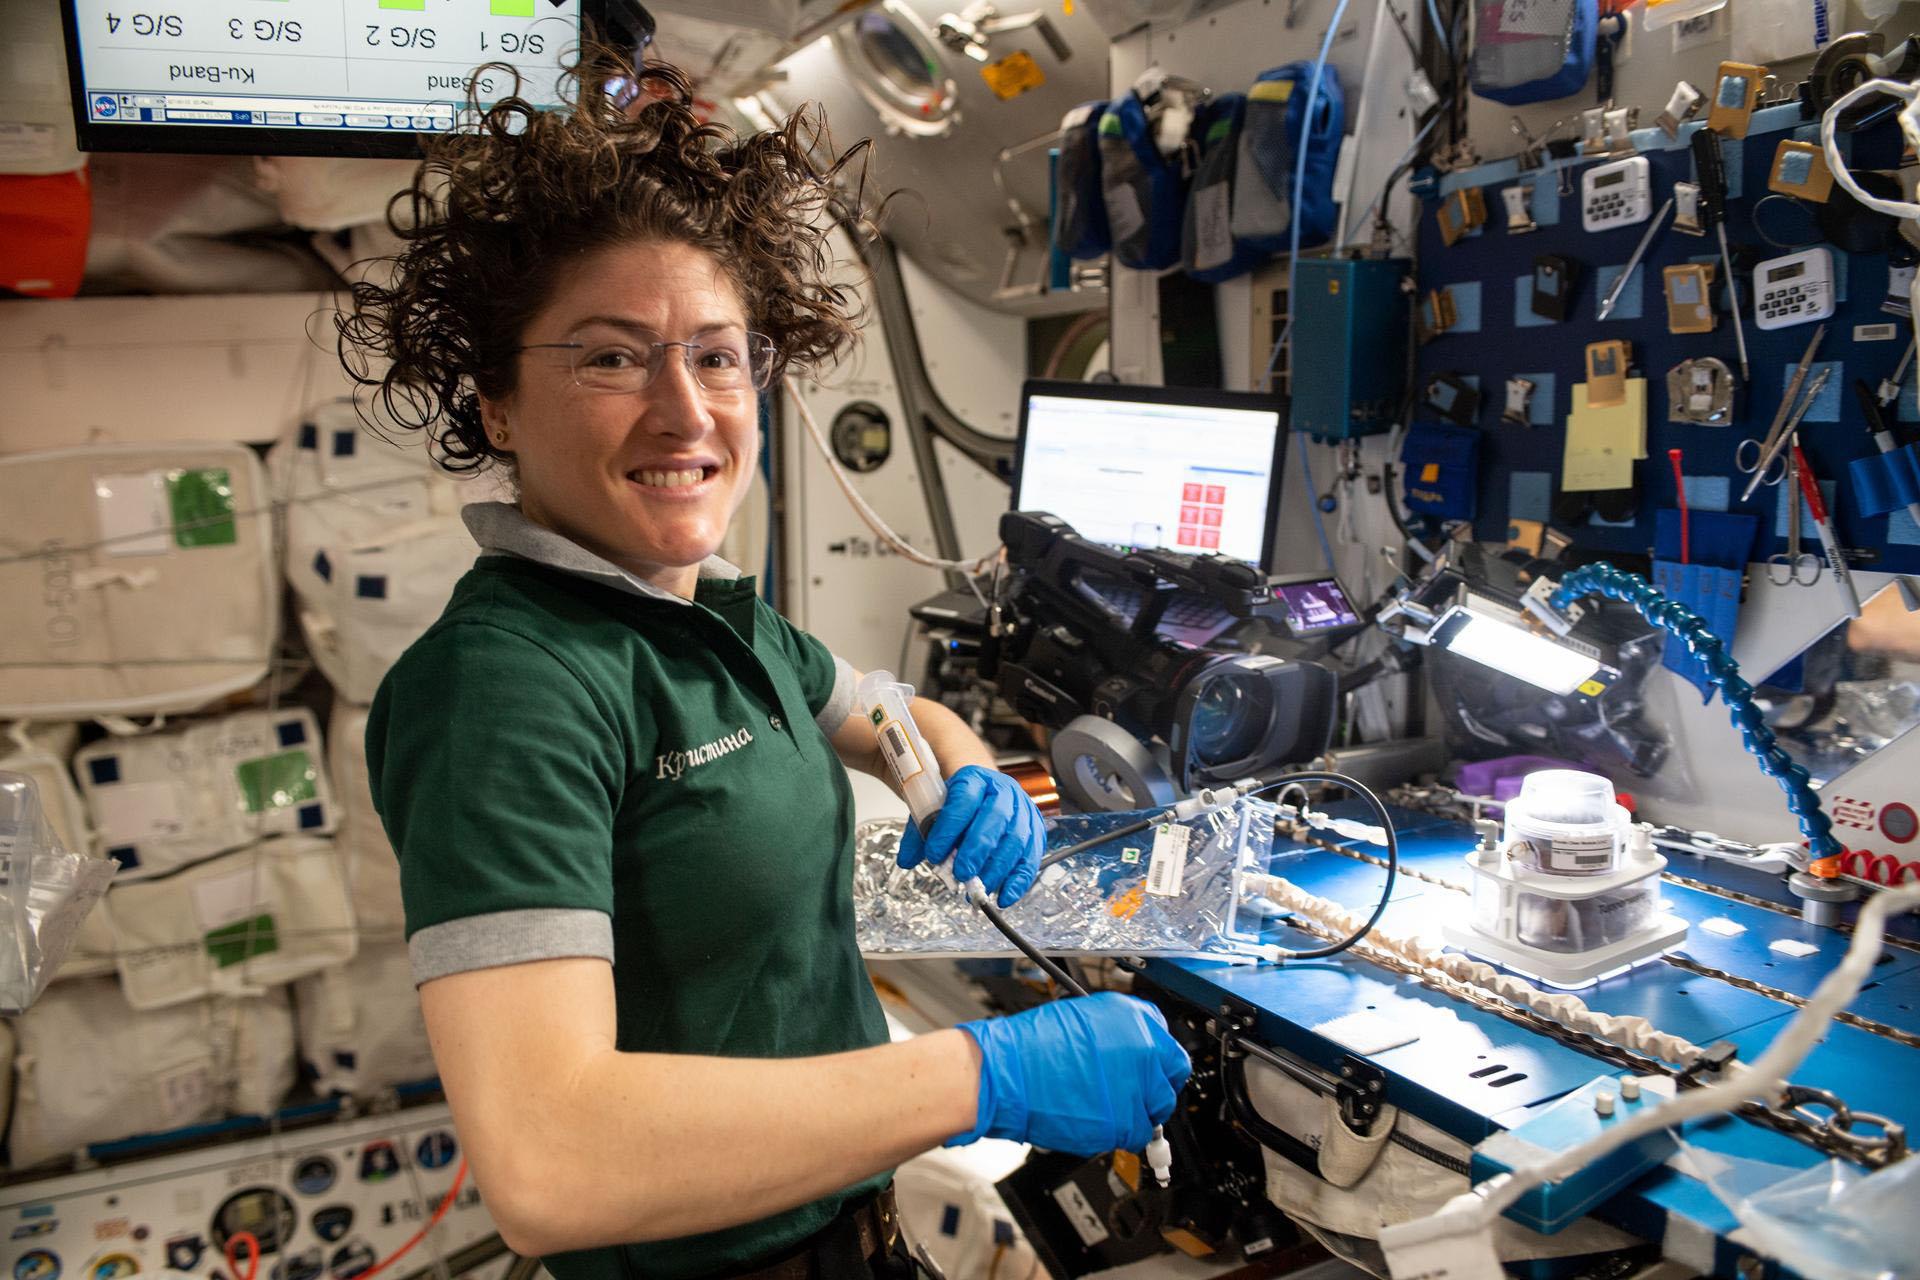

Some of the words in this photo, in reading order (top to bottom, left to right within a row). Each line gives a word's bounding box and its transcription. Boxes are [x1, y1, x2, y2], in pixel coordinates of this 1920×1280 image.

[105, 12, 121, 34] 4
[132, 14, 183, 37] S/G
[228, 18, 243, 40] 3
[254, 19, 302, 42] S/G
[366, 25, 380, 46] 2
[391, 26, 436, 49] S/G
[480, 31, 489, 51] 1
[501, 32, 545, 54] S/G
[170, 65, 255, 84] Ku-Band
[428, 75, 494, 94] S-Band
[1023, 678, 1057, 703] Canon
[656, 727, 754, 781] Кристина
